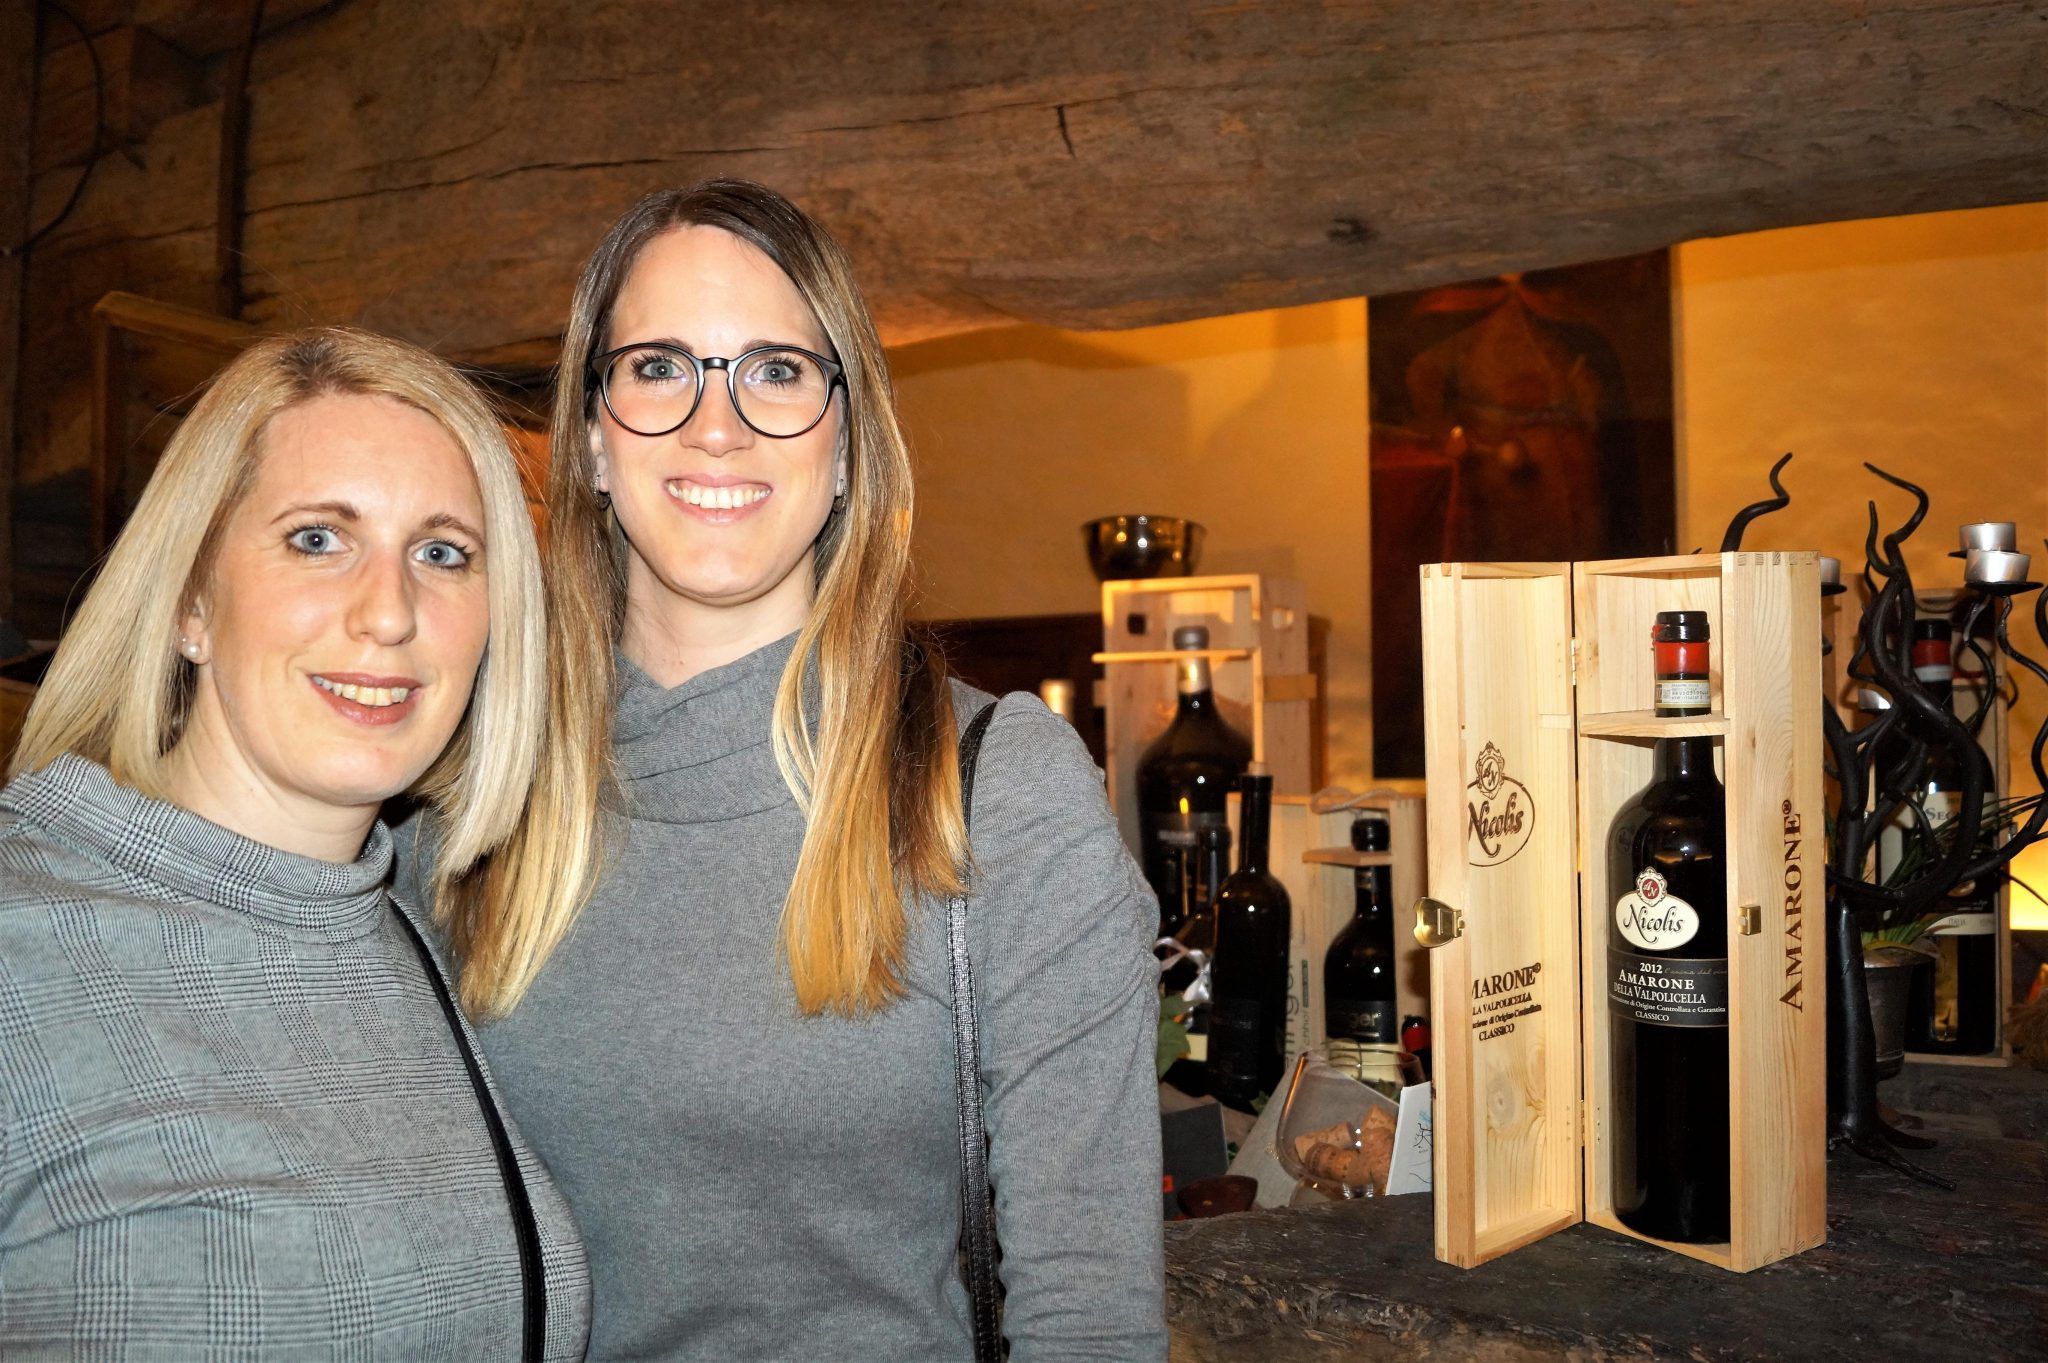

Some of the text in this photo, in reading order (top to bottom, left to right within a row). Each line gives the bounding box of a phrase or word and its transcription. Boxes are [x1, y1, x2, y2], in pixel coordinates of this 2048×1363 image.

[1623, 903, 1684, 944] Nicolis
[1639, 962, 1663, 974] 2012
[1619, 968, 1695, 990] AMARONE
[1483, 992, 1532, 1013] VALPOLICELLA
[1613, 981, 1633, 997] DELLA
[1633, 985, 1707, 1004] VALPOLICELLA
[1635, 1000, 1656, 1011] Origine
[1656, 1004, 1691, 1013] Controllata
[1635, 1010, 1670, 1022] CLASSICO
[1478, 1022, 1515, 1042] CLASSICO
